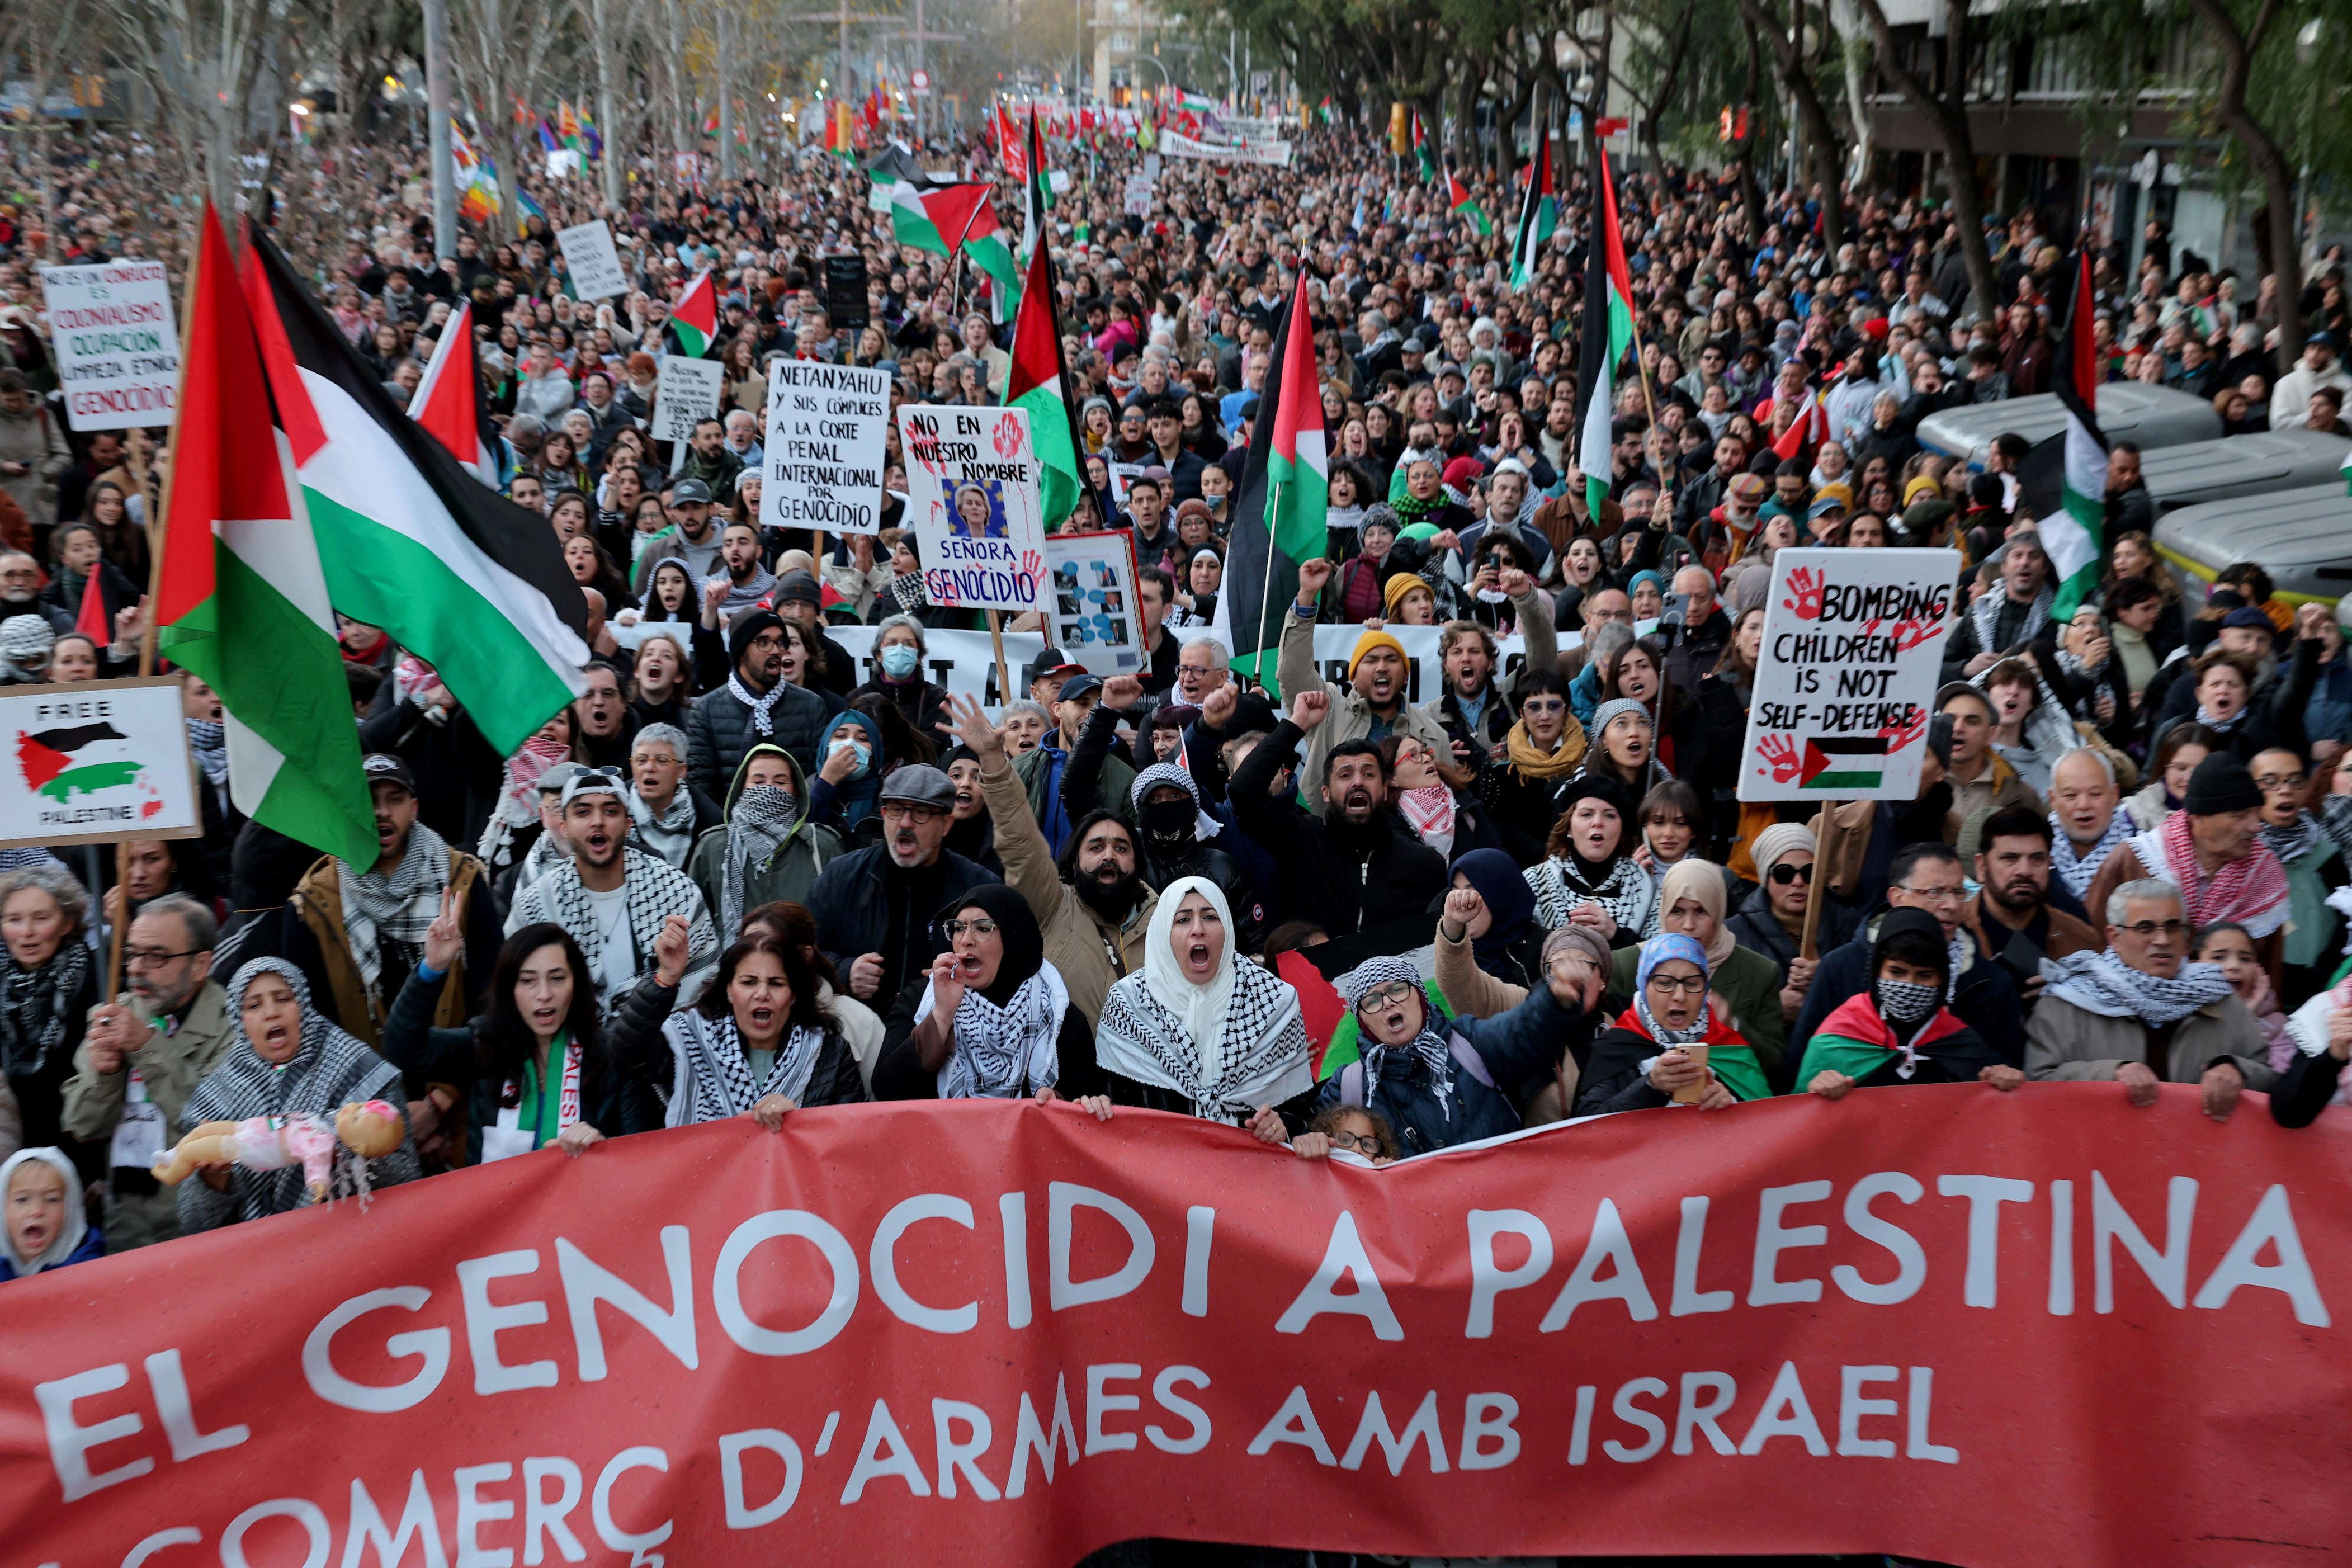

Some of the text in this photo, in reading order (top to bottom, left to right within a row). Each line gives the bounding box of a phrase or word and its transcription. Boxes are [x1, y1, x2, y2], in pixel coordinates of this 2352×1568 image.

[88, 286, 110, 300] ES
[780, 365, 882, 394] NETANYAHU
[776, 392, 785, 409] Y
[794, 394, 818, 412] SUS
[775, 420, 859, 440] A LA CORTE
[913, 414, 981, 436] NO EN
[788, 440, 844, 463] PENAL
[912, 442, 978, 464] NUESTRO
[962, 463, 1028, 482] NOMBRE
[808, 485, 834, 500] POR
[941, 538, 1017, 561] SEÑORA
[1836, 669, 1898, 699] NOT
[35, 701, 114, 722] FREE
[1756, 701, 1918, 733] SELF-DEFENSE
[39, 805, 135, 826] PALESTINE
[561, 1043, 584, 1123] PALES
[35, 1170, 2331, 1503] EL GENOCIDI A PALESTINA
[718, 1362, 1212, 1531] D'ARMES
[1247, 1385, 1521, 1477] AMB
[1567, 1359, 1958, 1466] ISRAEL
